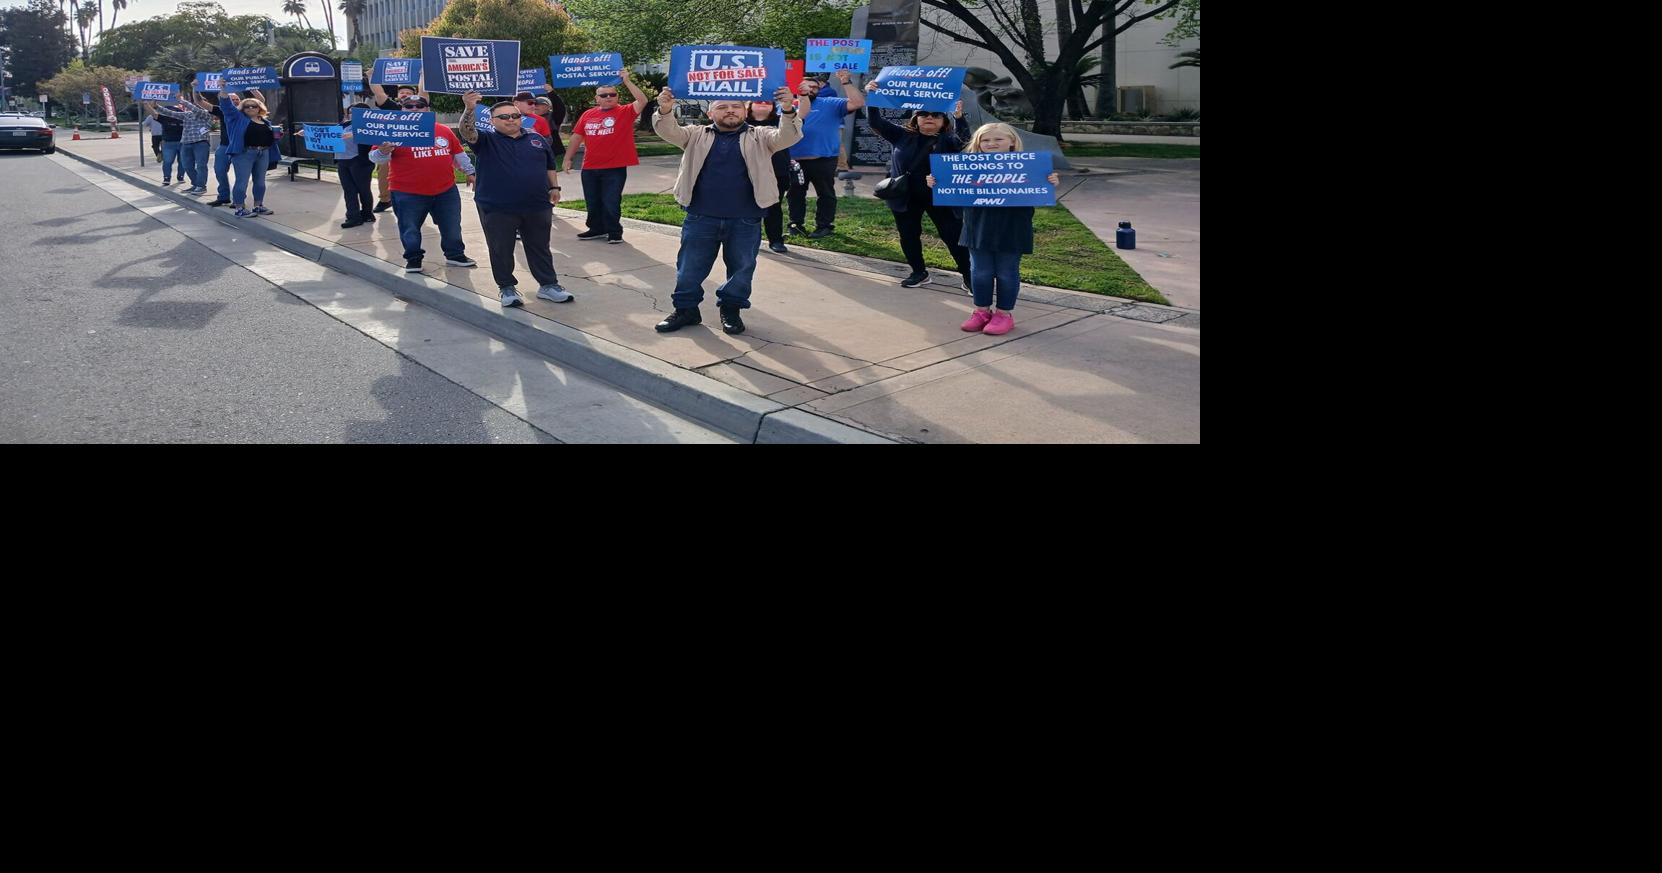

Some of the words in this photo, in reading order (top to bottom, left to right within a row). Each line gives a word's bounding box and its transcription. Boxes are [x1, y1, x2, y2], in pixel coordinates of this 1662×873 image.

[445, 46, 488, 57] SAVE
[448, 63, 488, 72] AMERICA'S
[700, 55, 753, 70] U.S.
[448, 74, 494, 82] POSTAL
[688, 72, 711, 82] NOT
[713, 70, 735, 80] FOR
[737, 69, 764, 78] SALE
[888, 67, 924, 78] Hands
[926, 68, 952, 78] off!
[698, 81, 752, 92] MAIL
[910, 82, 944, 90] PUBLIC
[875, 88, 911, 97] POSTAL
[914, 91, 954, 100] SERVICE
[363, 110, 395, 120] Hands
[400, 112, 423, 121] off!
[414, 150, 432, 158] LIKE
[951, 174, 973, 184] THE
[976, 173, 1028, 184] PEOPLE
